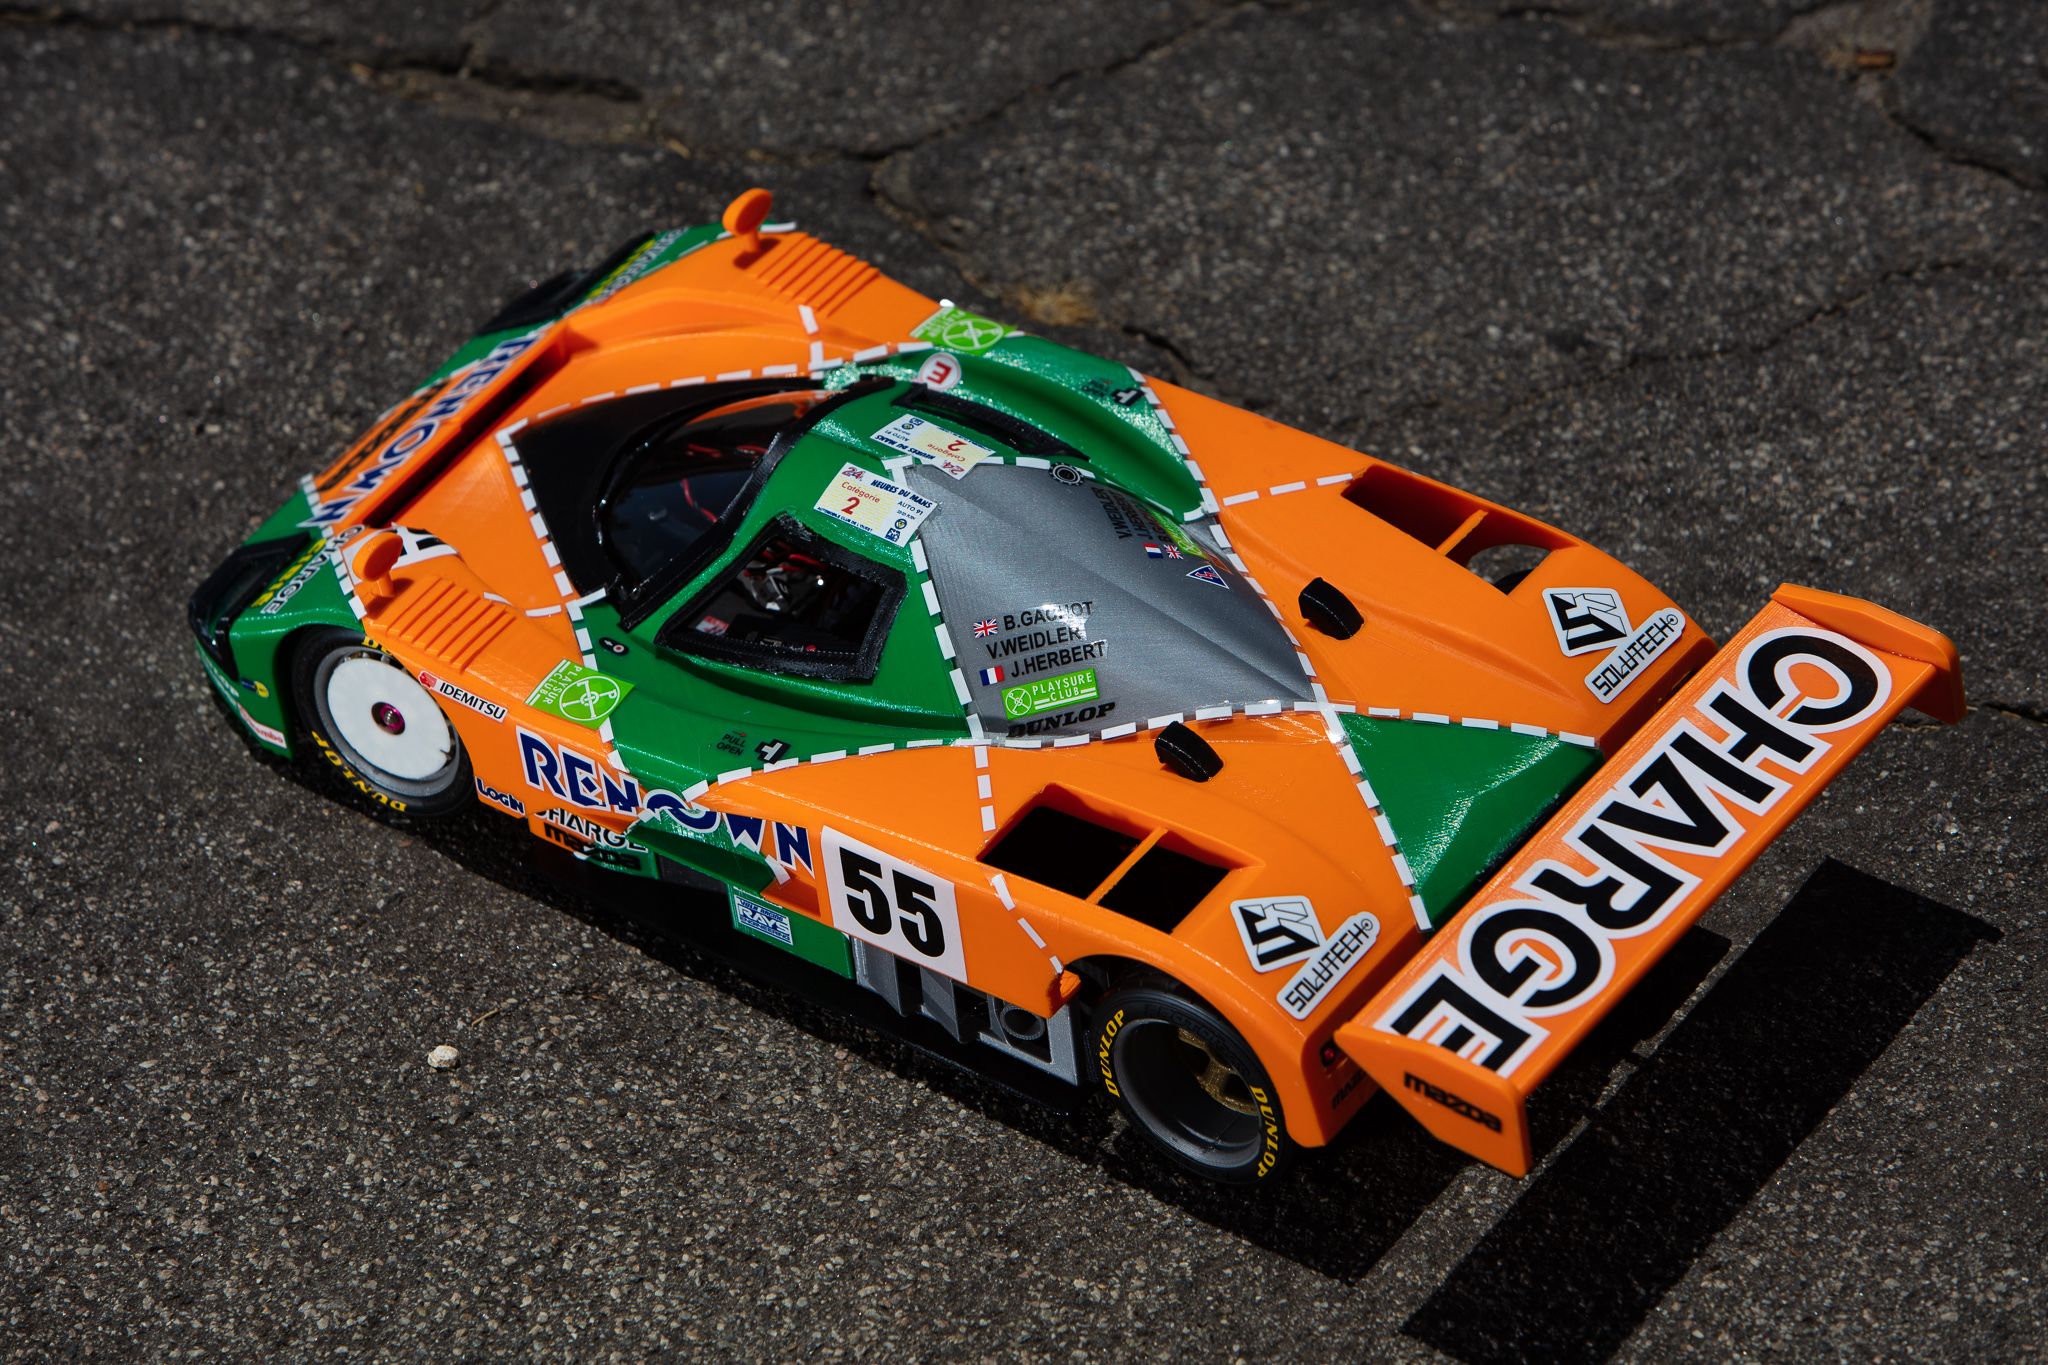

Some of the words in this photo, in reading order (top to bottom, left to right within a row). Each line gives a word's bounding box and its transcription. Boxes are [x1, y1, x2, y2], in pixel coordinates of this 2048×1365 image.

[299, 332, 544, 526] RENOWN
[875, 434, 897, 446] MANS
[896, 443, 909, 454] DU
[947, 439, 968, 452] 2
[842, 466, 865, 480] 24
[943, 461, 965, 475] 24
[841, 496, 861, 516] 2
[870, 479, 899, 495] HEURES
[898, 488, 911, 498] DU
[909, 494, 933, 509] MANS
[897, 501, 916, 512] AUTO
[260, 524, 365, 614] CHARGE
[1003, 601, 1093, 631] B.GACOT
[986, 626, 1082, 660] V.WEIDLER
[1011, 640, 1105, 678] J.HERBERT
[1591, 616, 1675, 697] SOLUTECH
[539, 672, 563, 695] CLUB
[1032, 672, 1093, 696] PLAYSURE
[1050, 687, 1080, 701] CLUB
[439, 681, 507, 721] IDEMITSU
[1008, 702, 1116, 738] DUNLOP
[716, 742, 745, 757] OPEN
[722, 733, 746, 748] PULL
[312, 730, 408, 813] DUNLOP
[516, 725, 815, 880] RENOWN
[1384, 630, 1886, 1075] CHARGE
[838, 845, 946, 958] 55
[739, 905, 790, 935] RAYS
[1285, 923, 1370, 1012] SOLUTECH
[1099, 1009, 1126, 1099] DUNLOP
[1403, 1071, 1503, 1134] mazda
[1250, 1085, 1278, 1179] DUNLOP
